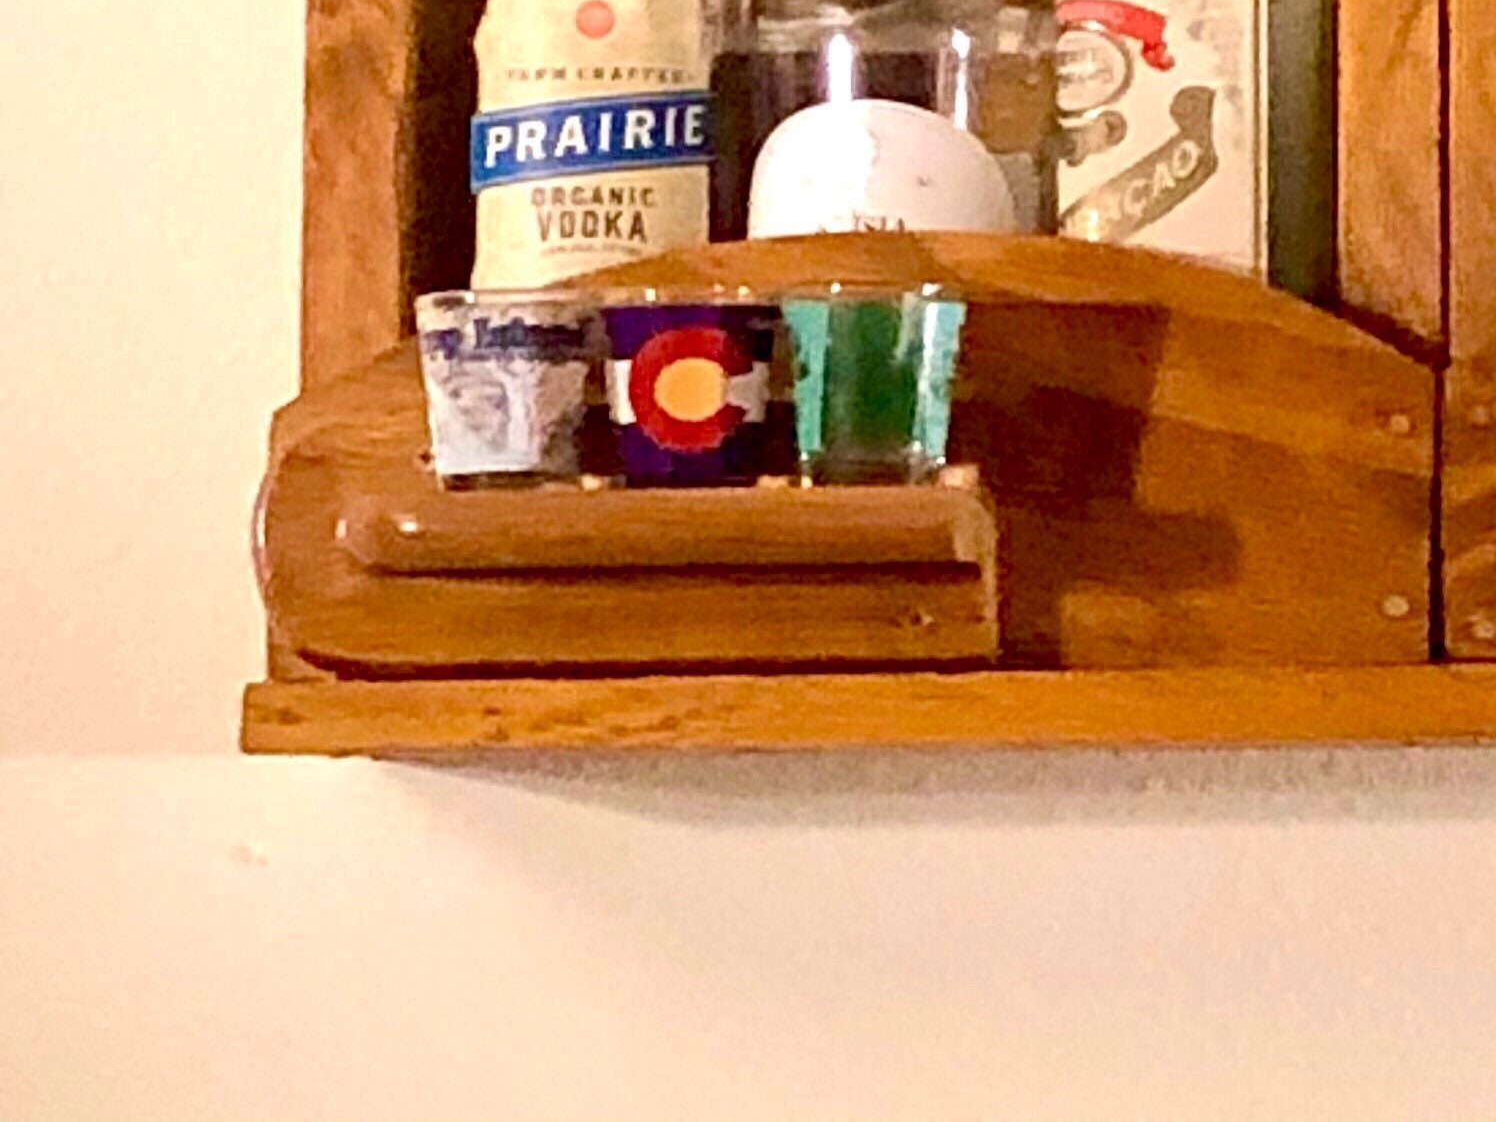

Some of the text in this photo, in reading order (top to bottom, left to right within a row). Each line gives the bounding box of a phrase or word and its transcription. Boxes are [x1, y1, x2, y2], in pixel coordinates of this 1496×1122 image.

[484, 105, 706, 168] PRAIRIE
[531, 186, 657, 208] ORGANIC
[537, 209, 647, 244] VODKA
